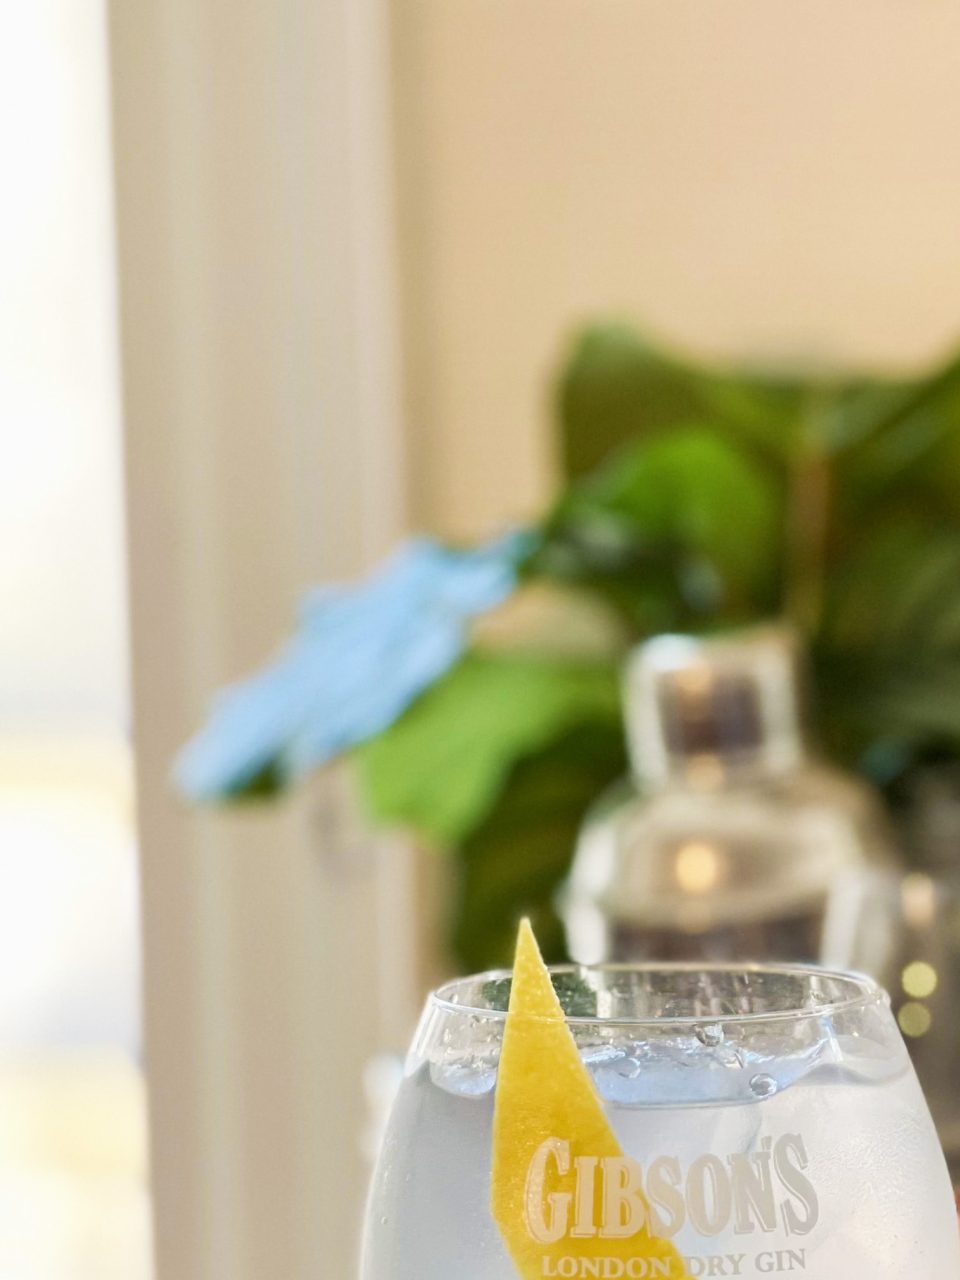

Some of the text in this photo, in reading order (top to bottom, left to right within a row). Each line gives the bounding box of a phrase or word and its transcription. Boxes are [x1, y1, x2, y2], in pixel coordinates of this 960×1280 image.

[524, 1132, 820, 1245] GIBSON'S
[543, 1248, 806, 1279] LONDON DRY GIN
